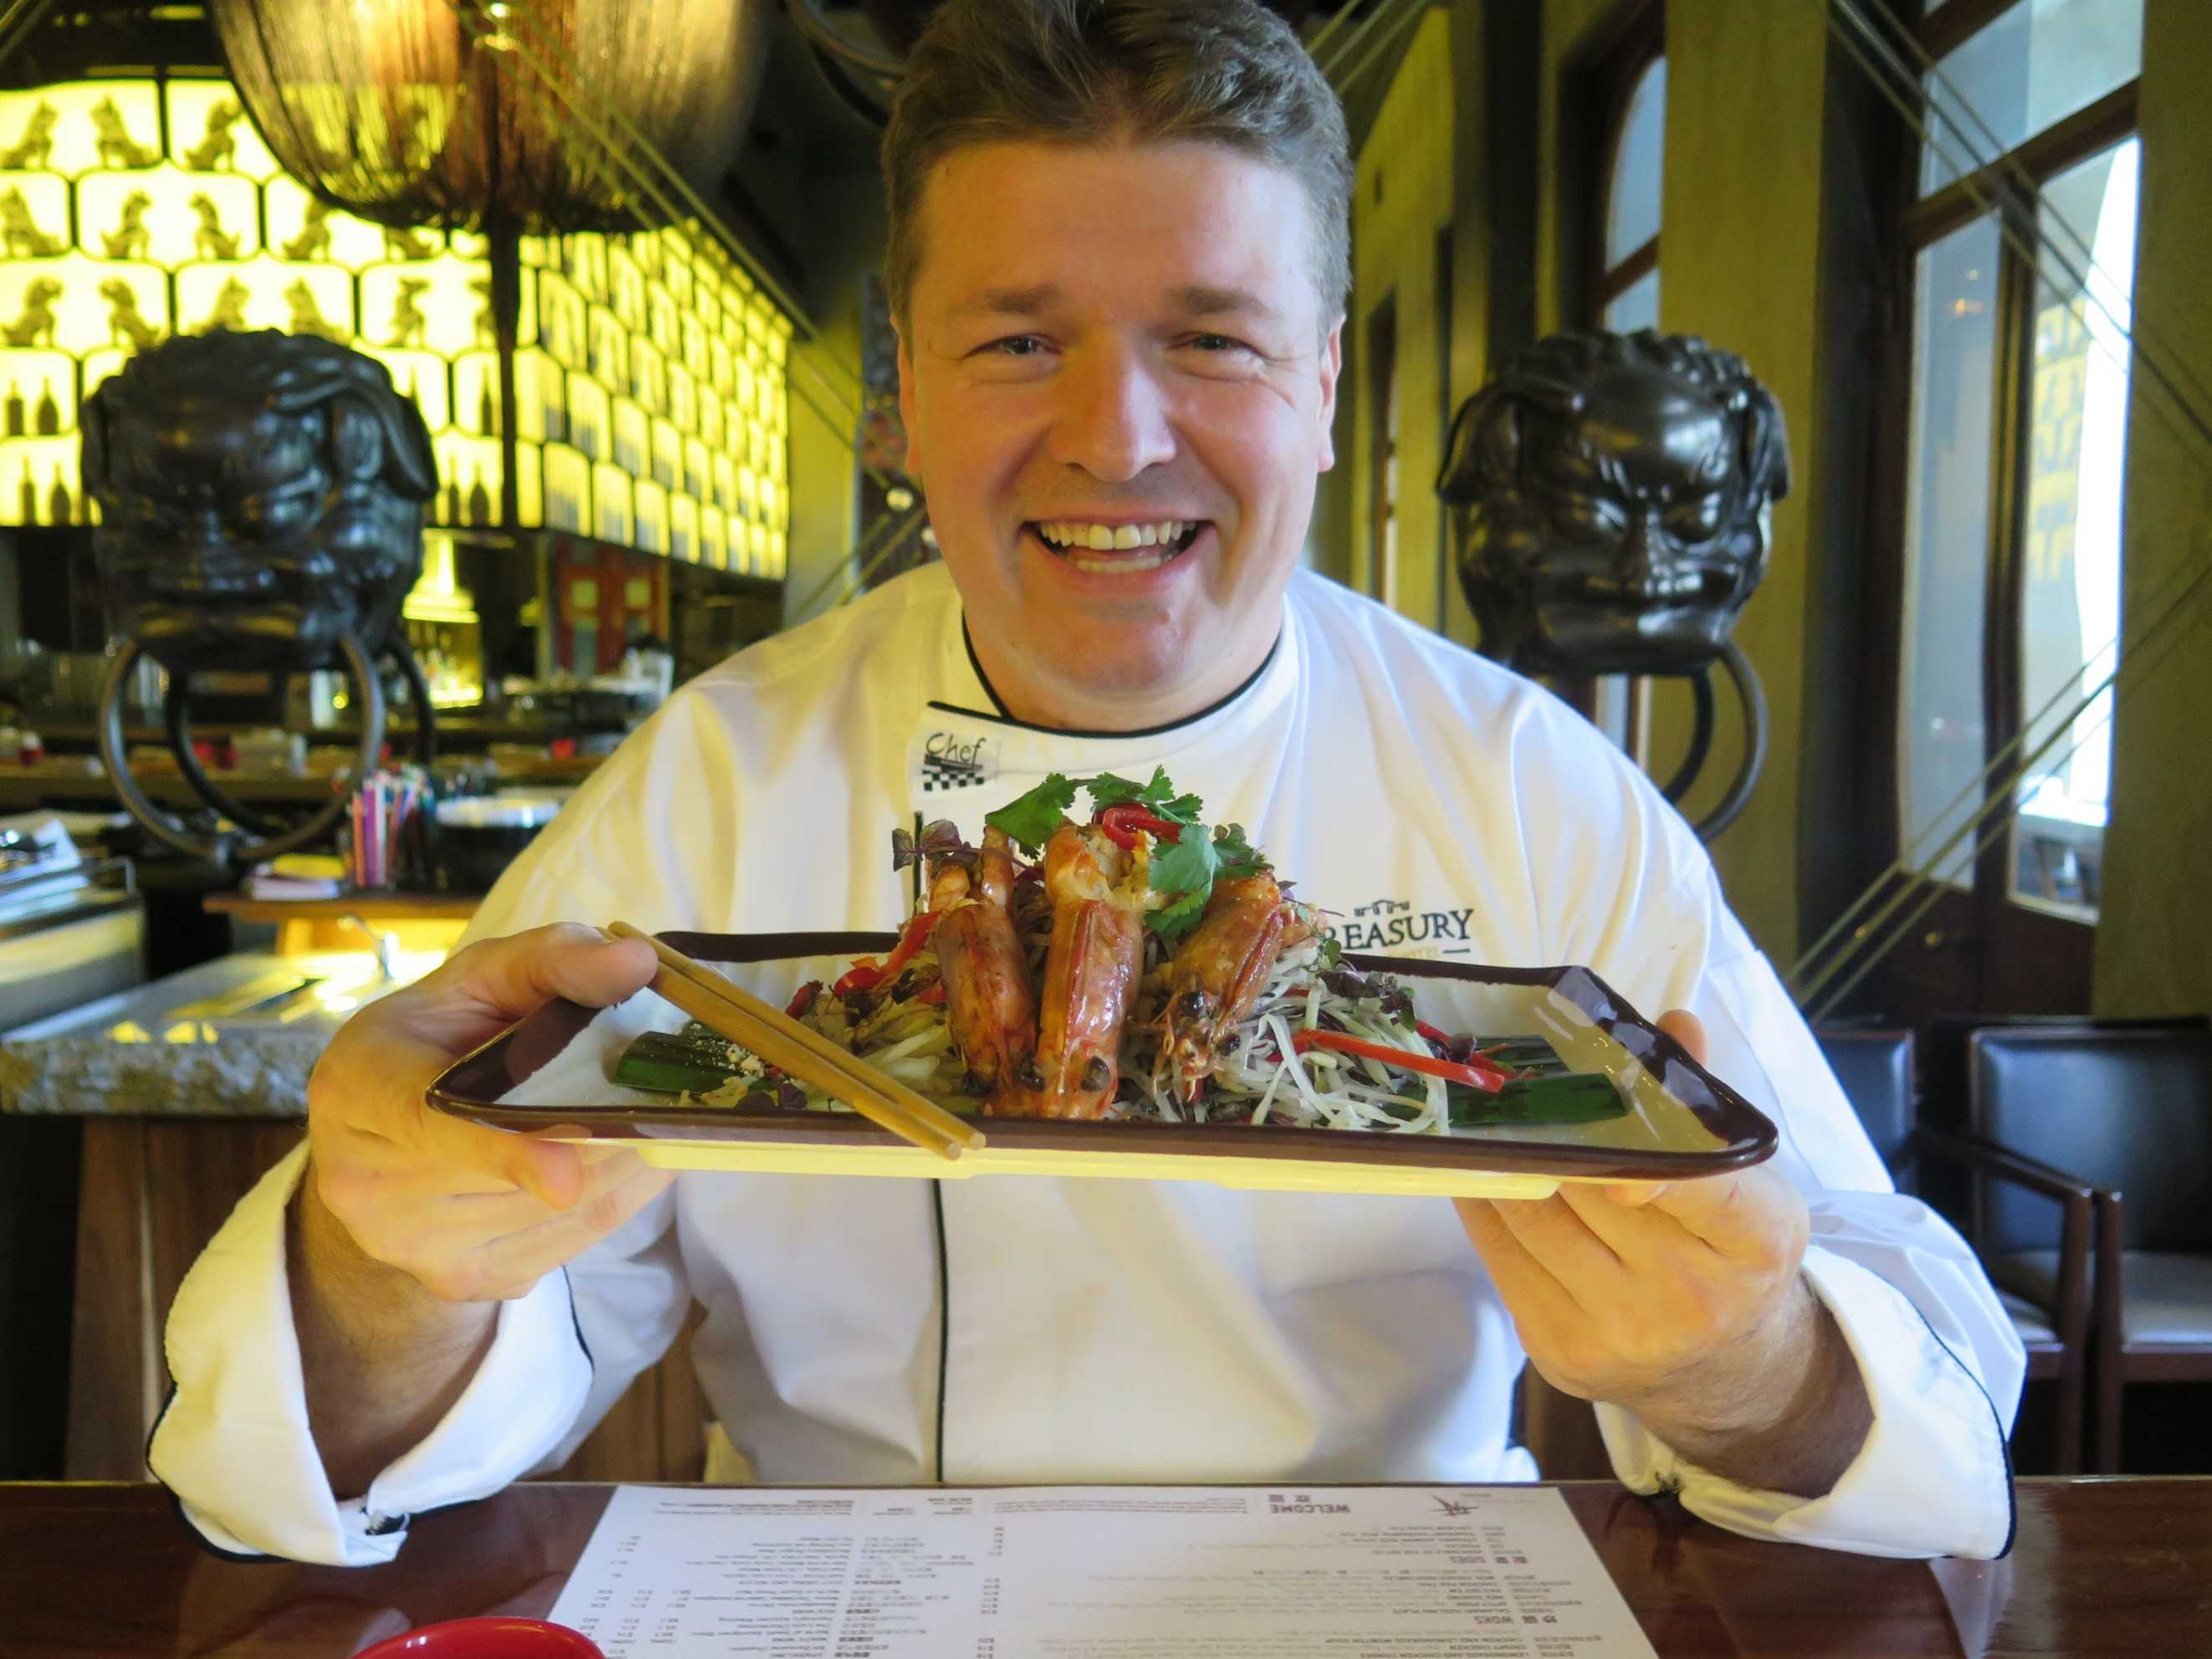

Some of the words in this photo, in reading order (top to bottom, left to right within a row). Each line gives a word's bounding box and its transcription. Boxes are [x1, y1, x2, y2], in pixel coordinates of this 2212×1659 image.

[925, 733, 986, 769] Chef
[1324, 909, 1474, 950] EASURY
[1270, 1503, 1351, 1513] WELCOME
[1449, 1556, 1487, 1564] SIDES
[1472, 1615, 1513, 1625] WOKS
